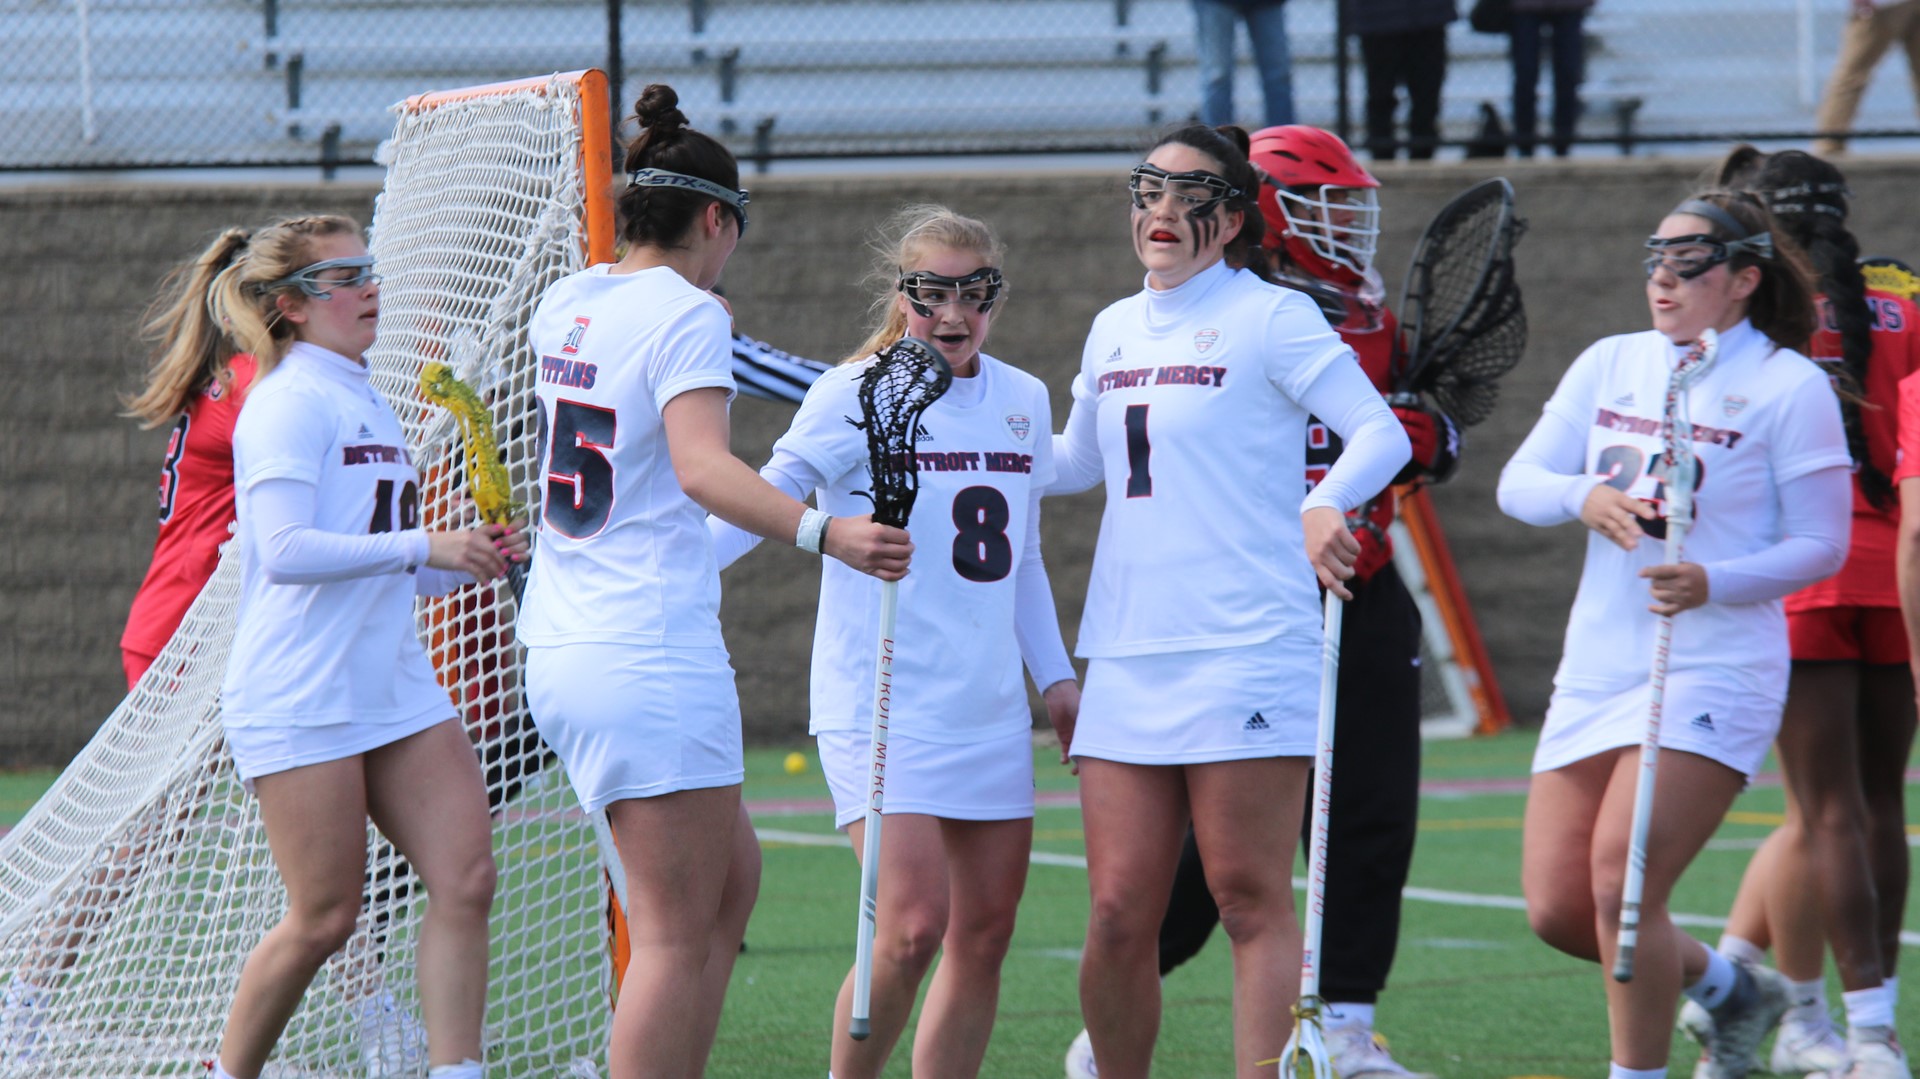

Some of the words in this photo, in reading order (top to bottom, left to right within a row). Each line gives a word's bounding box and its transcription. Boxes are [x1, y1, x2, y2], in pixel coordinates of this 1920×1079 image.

[650, 174, 697, 189] STX
[541, 355, 598, 390] TITANS
[1155, 364, 1227, 388] MERCY
[536, 395, 617, 540] 5
[983, 451, 1033, 474] MERC
[1124, 403, 1153, 499] 1
[952, 485, 1013, 582] 8
[872, 741, 887, 816] MERCY
